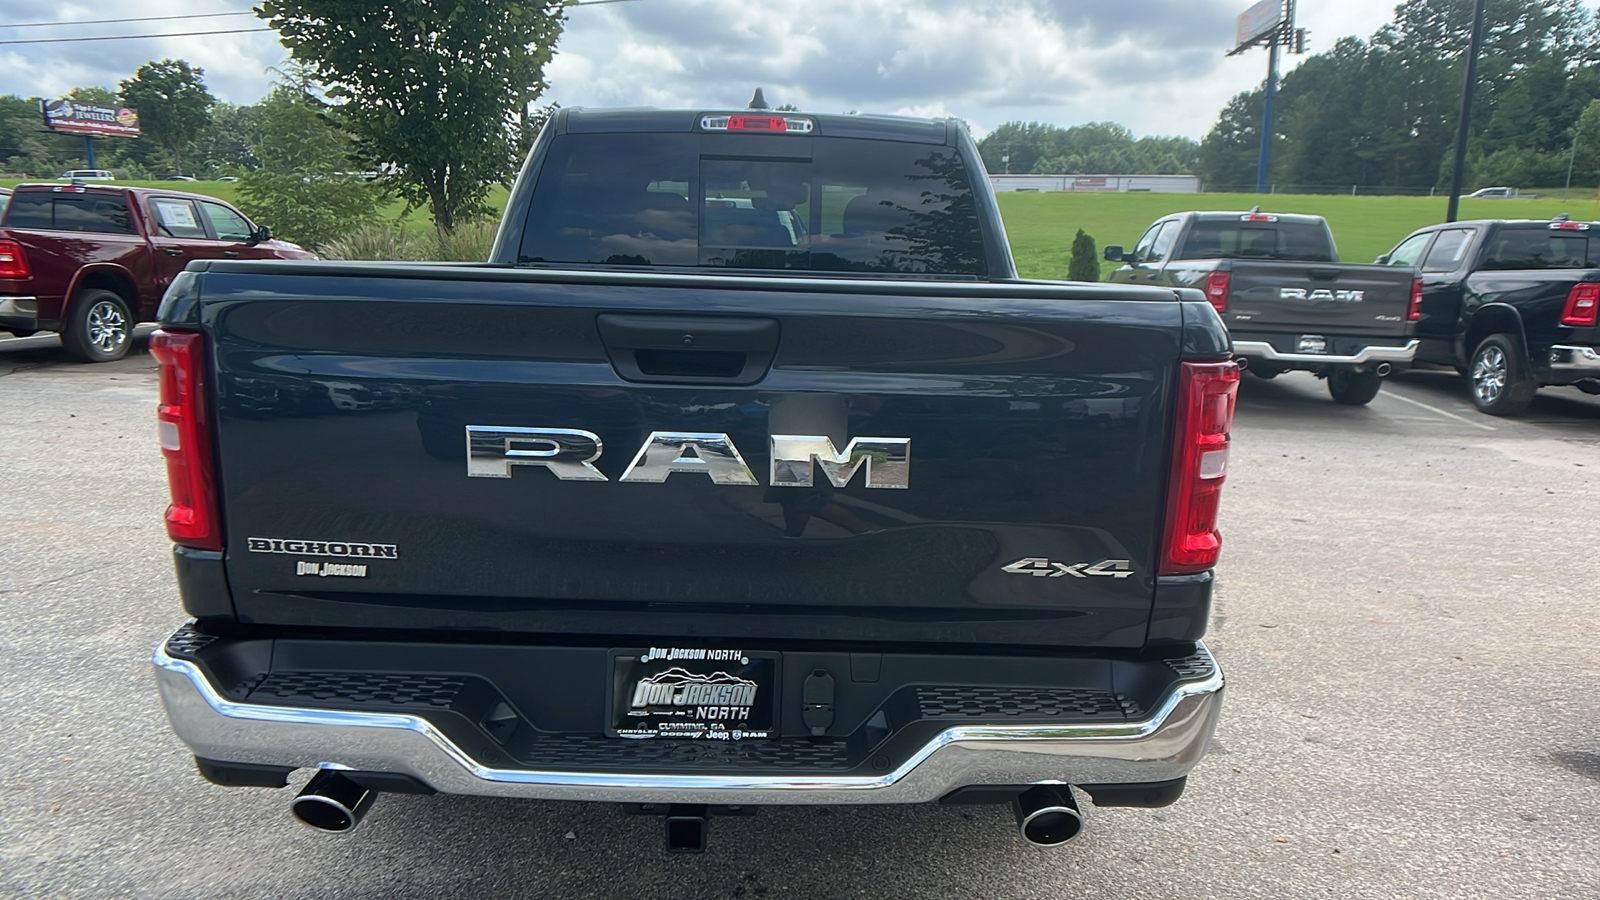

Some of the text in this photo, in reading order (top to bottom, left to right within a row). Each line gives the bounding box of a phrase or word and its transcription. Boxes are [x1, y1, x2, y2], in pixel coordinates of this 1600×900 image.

[75, 111, 116, 122] JEWELERS
[1279, 287, 1365, 301] RAM
[465, 424, 912, 490] RAM
[247, 537, 398, 559] BIGHORN
[1001, 557, 1135, 578] 4x4
[707, 649, 742, 661] NORTH
[673, 683, 758, 706] JACKSON
[695, 706, 750, 720] NORTH
[706, 730, 730, 740] Jeep
